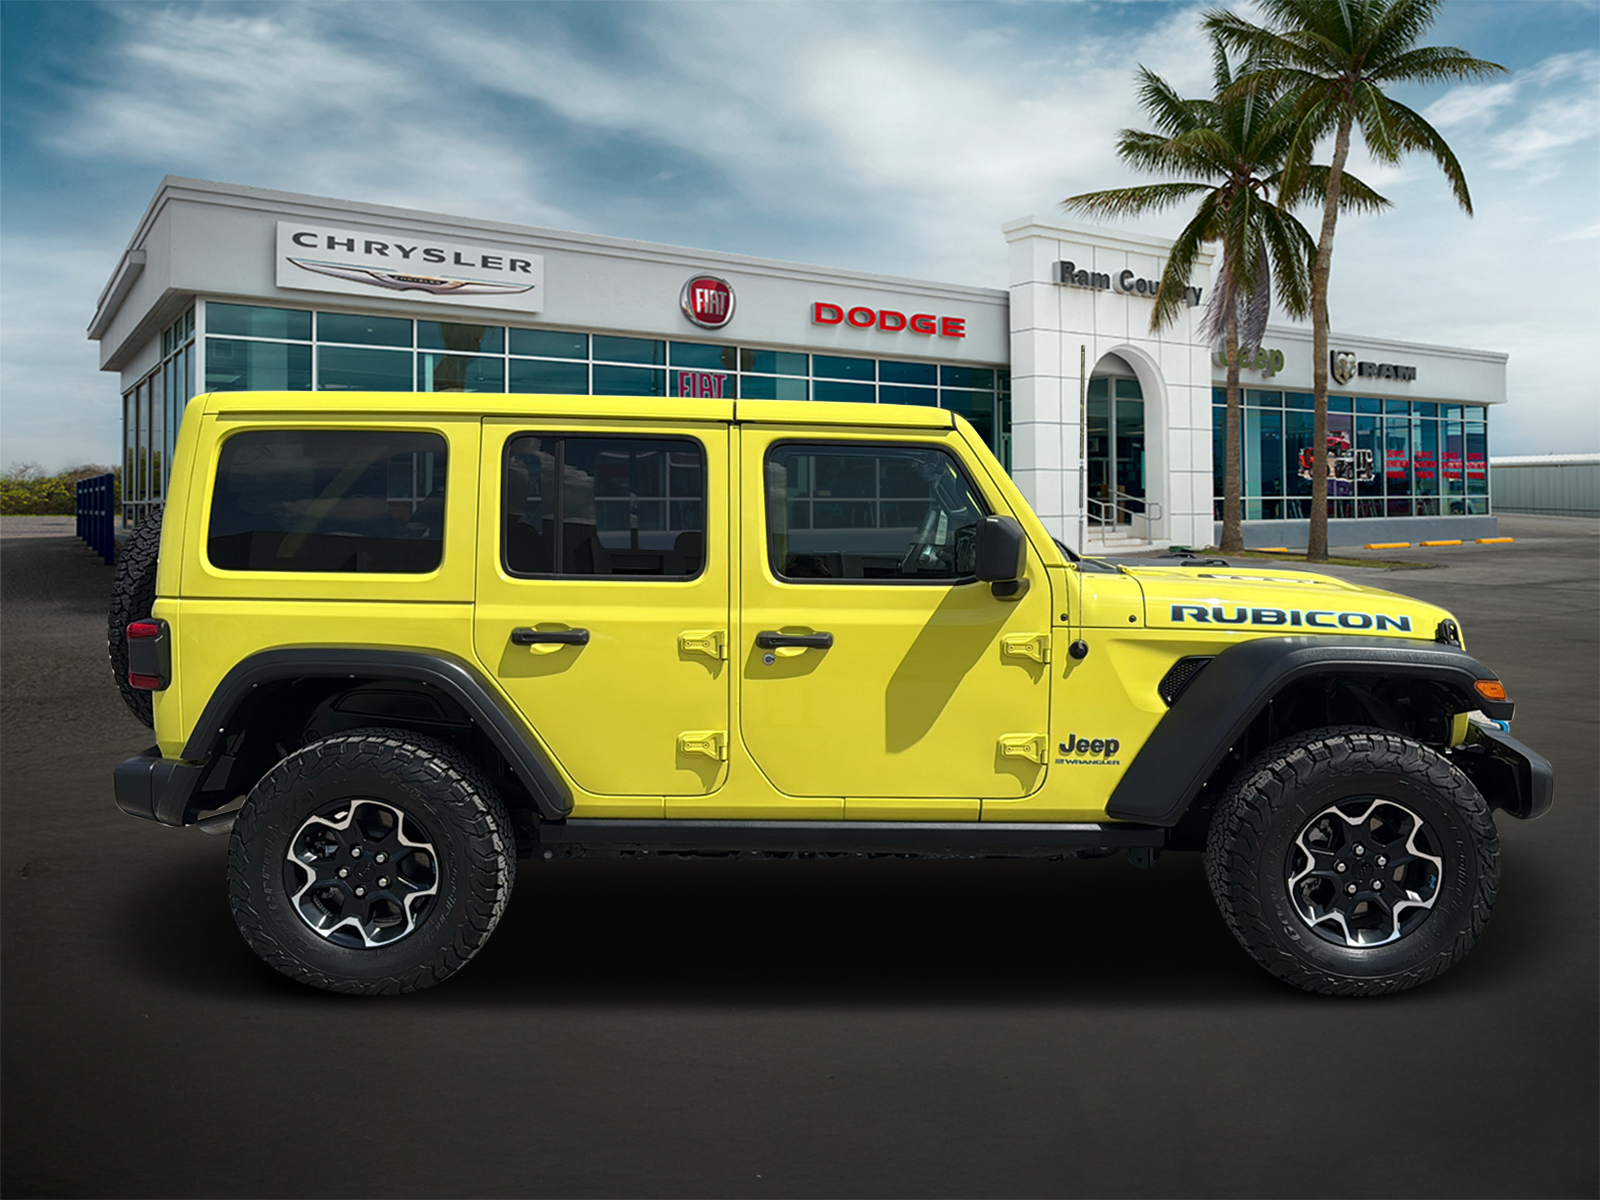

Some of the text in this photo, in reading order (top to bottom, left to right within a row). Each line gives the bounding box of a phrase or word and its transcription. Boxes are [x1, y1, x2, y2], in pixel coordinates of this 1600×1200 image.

[292, 232, 532, 274] CHRYSLER
[1058, 260, 1203, 306] Ram Coury
[695, 287, 728, 316] FIAT
[812, 301, 966, 338] DODGE
[678, 371, 727, 398] FIAT
[1358, 361, 1416, 381] RAM
[1171, 605, 1412, 632] RUBICON
[1060, 733, 1120, 757] Jeep
[1065, 758, 1120, 766] WRANGLER
